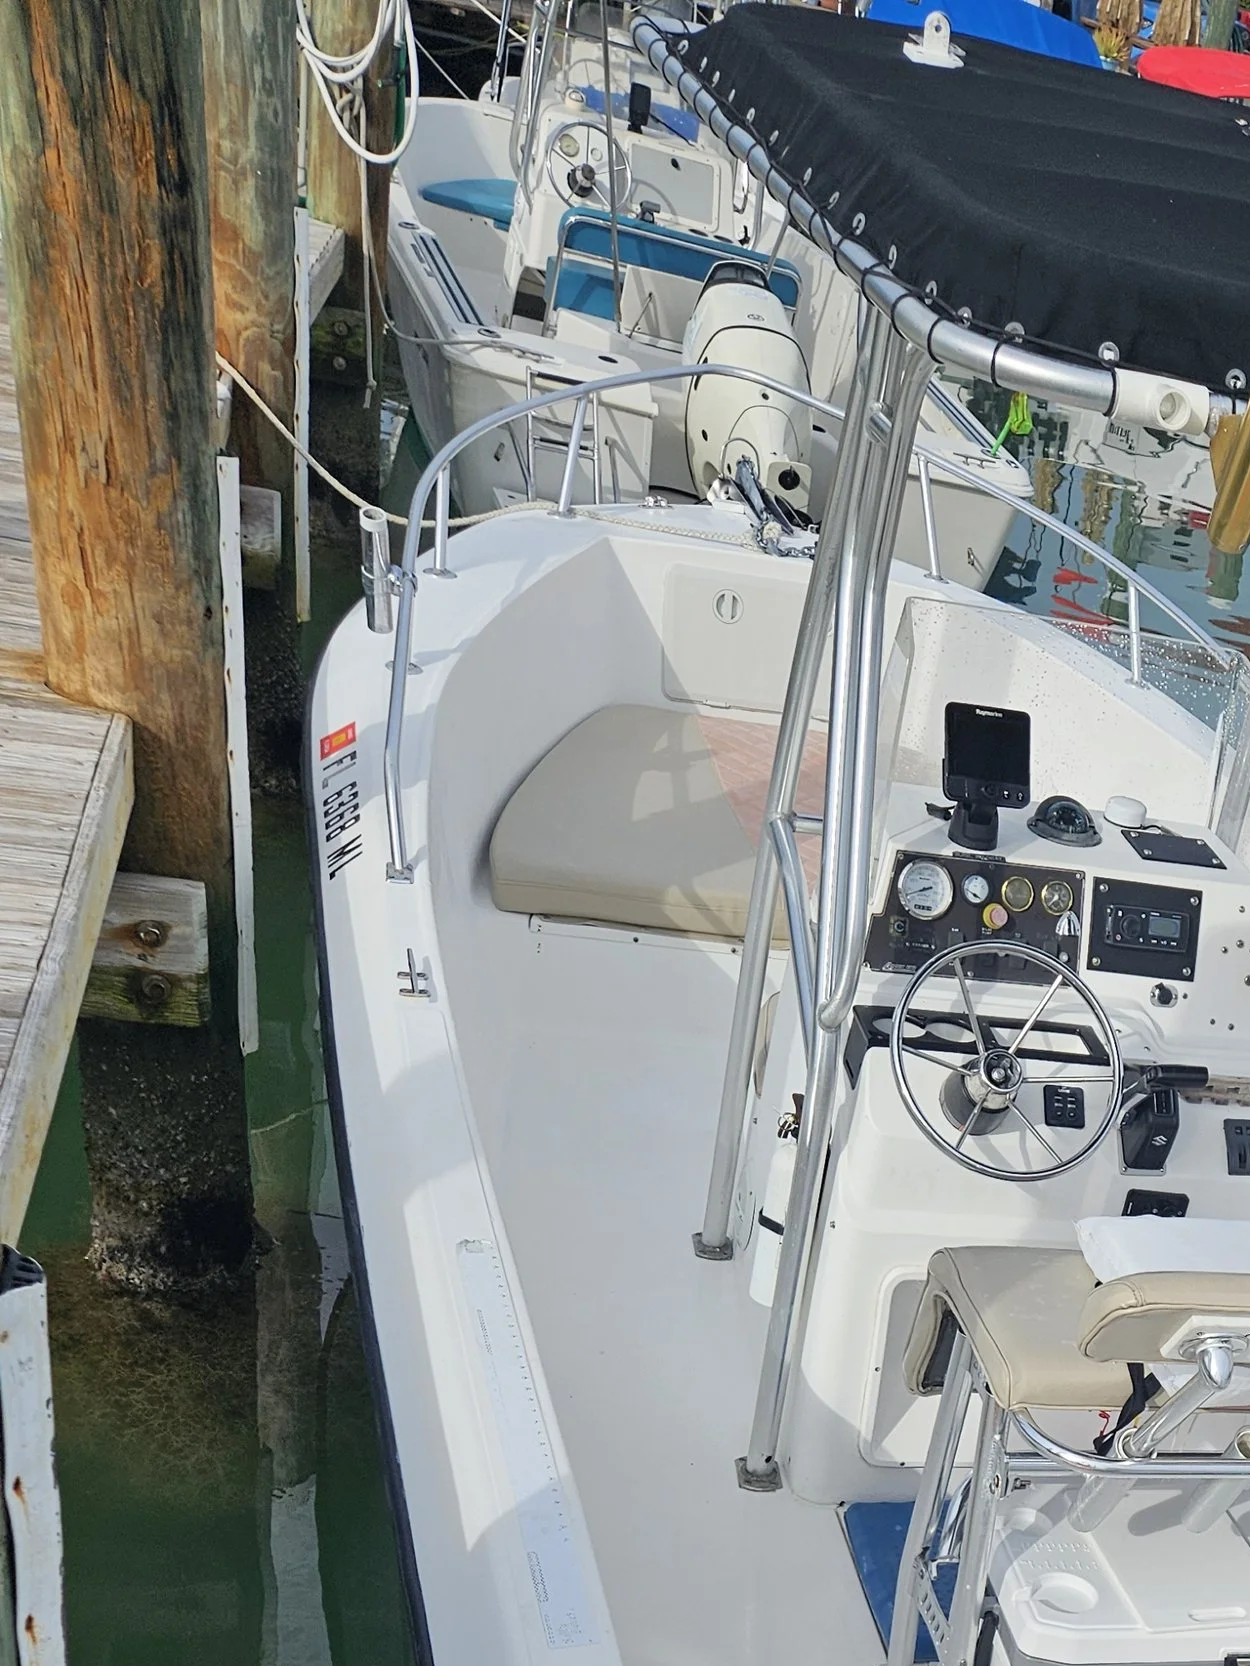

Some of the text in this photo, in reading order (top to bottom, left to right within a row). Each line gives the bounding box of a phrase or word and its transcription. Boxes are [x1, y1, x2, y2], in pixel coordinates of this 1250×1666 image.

[323, 750, 363, 881] FL 6368 ML
